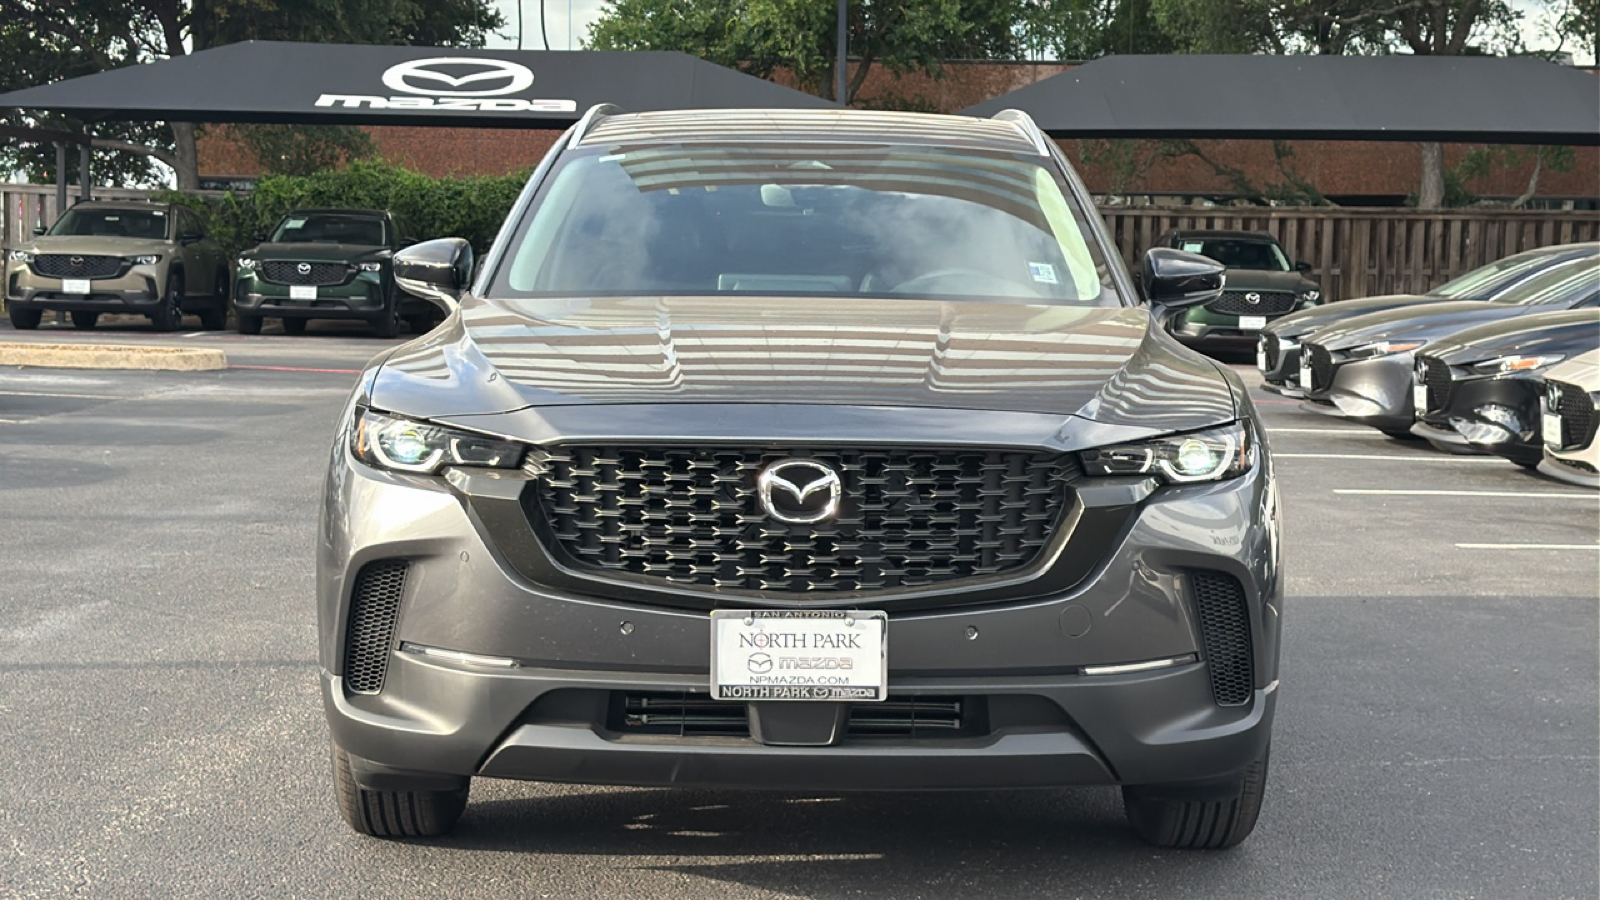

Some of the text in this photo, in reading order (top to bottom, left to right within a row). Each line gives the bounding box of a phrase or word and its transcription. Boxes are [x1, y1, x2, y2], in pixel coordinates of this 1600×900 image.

[314, 94, 577, 112] mazda
[739, 633, 861, 648] NORTH PARK
[778, 656, 853, 670] mazda
[749, 676, 849, 685] NPMAZDA.COM
[722, 686, 876, 697] NORTH PARK mazda
